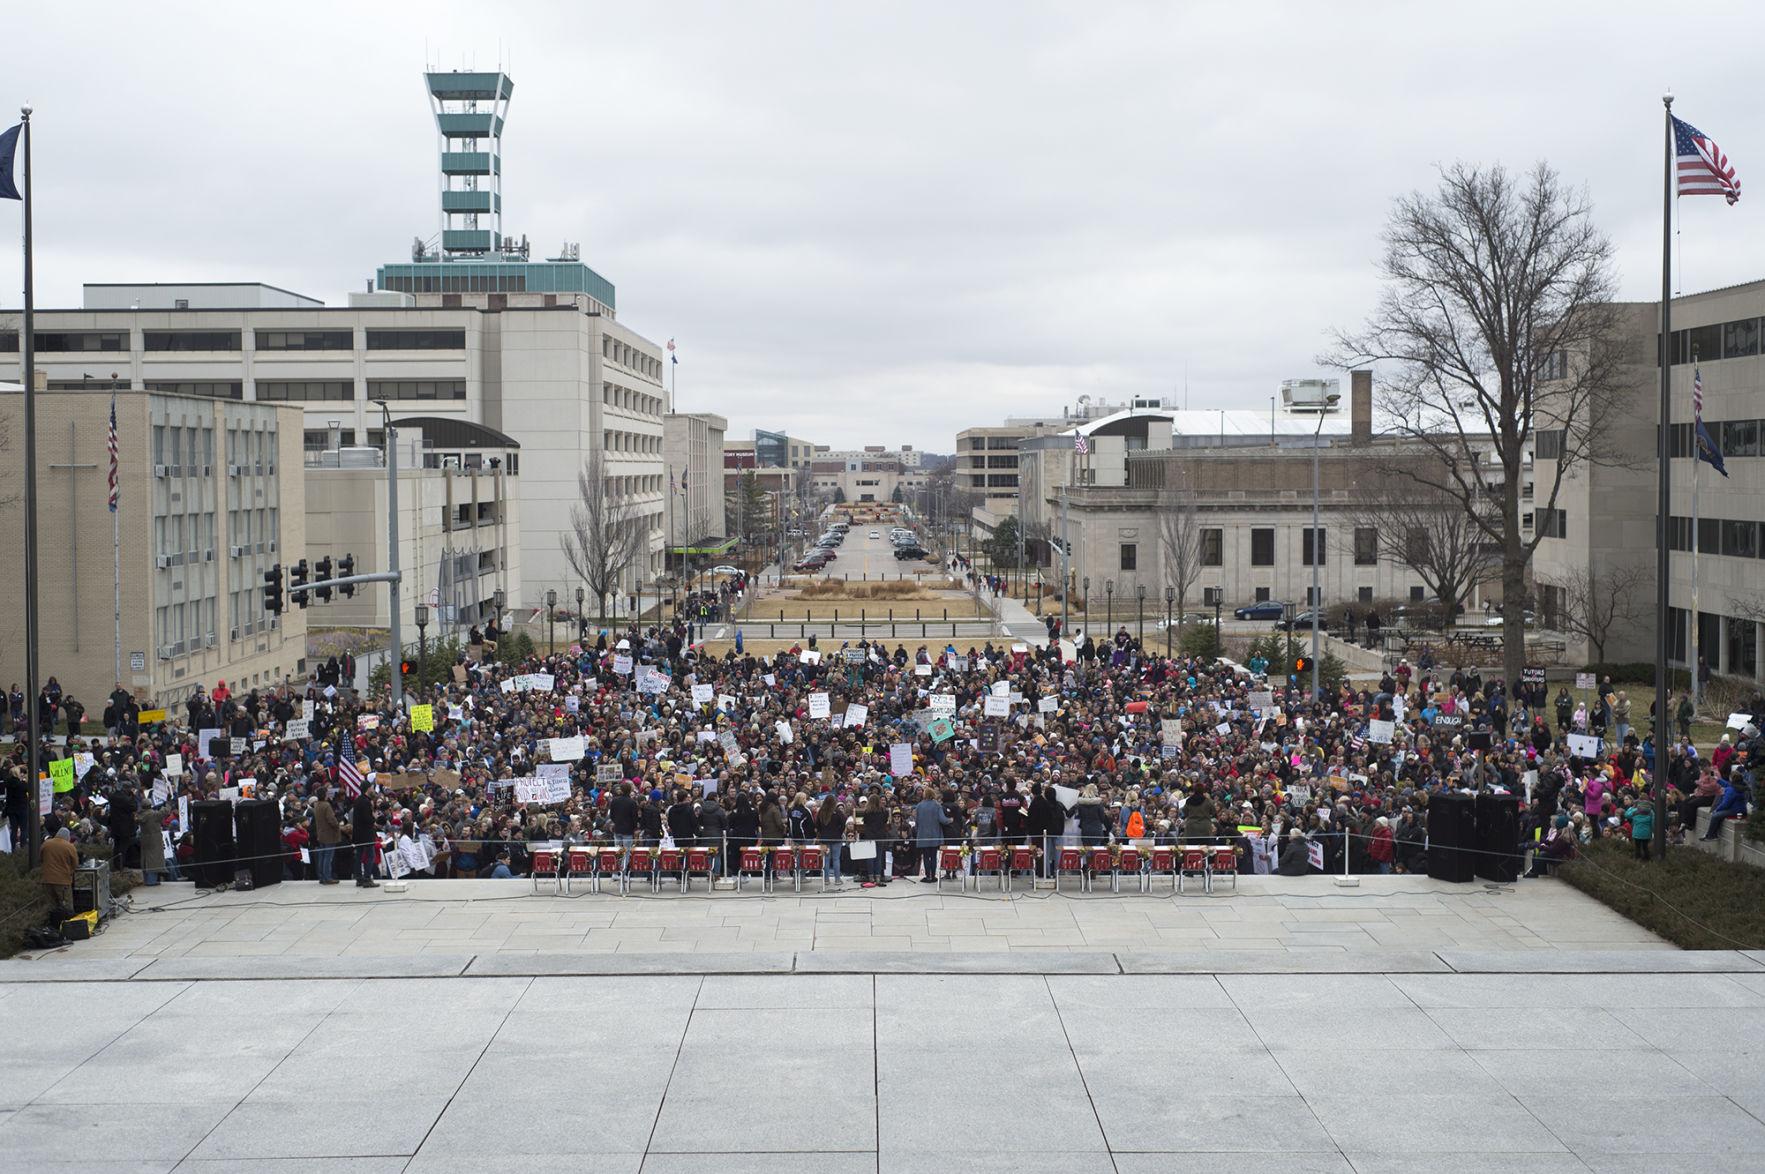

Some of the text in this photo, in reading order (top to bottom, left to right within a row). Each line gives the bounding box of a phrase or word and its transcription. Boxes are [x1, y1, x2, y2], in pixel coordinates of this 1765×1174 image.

[1524, 668, 1544, 676] TUTORS
[1436, 716, 1462, 726] ENOUGH
[515, 778, 546, 787] PROTECT
